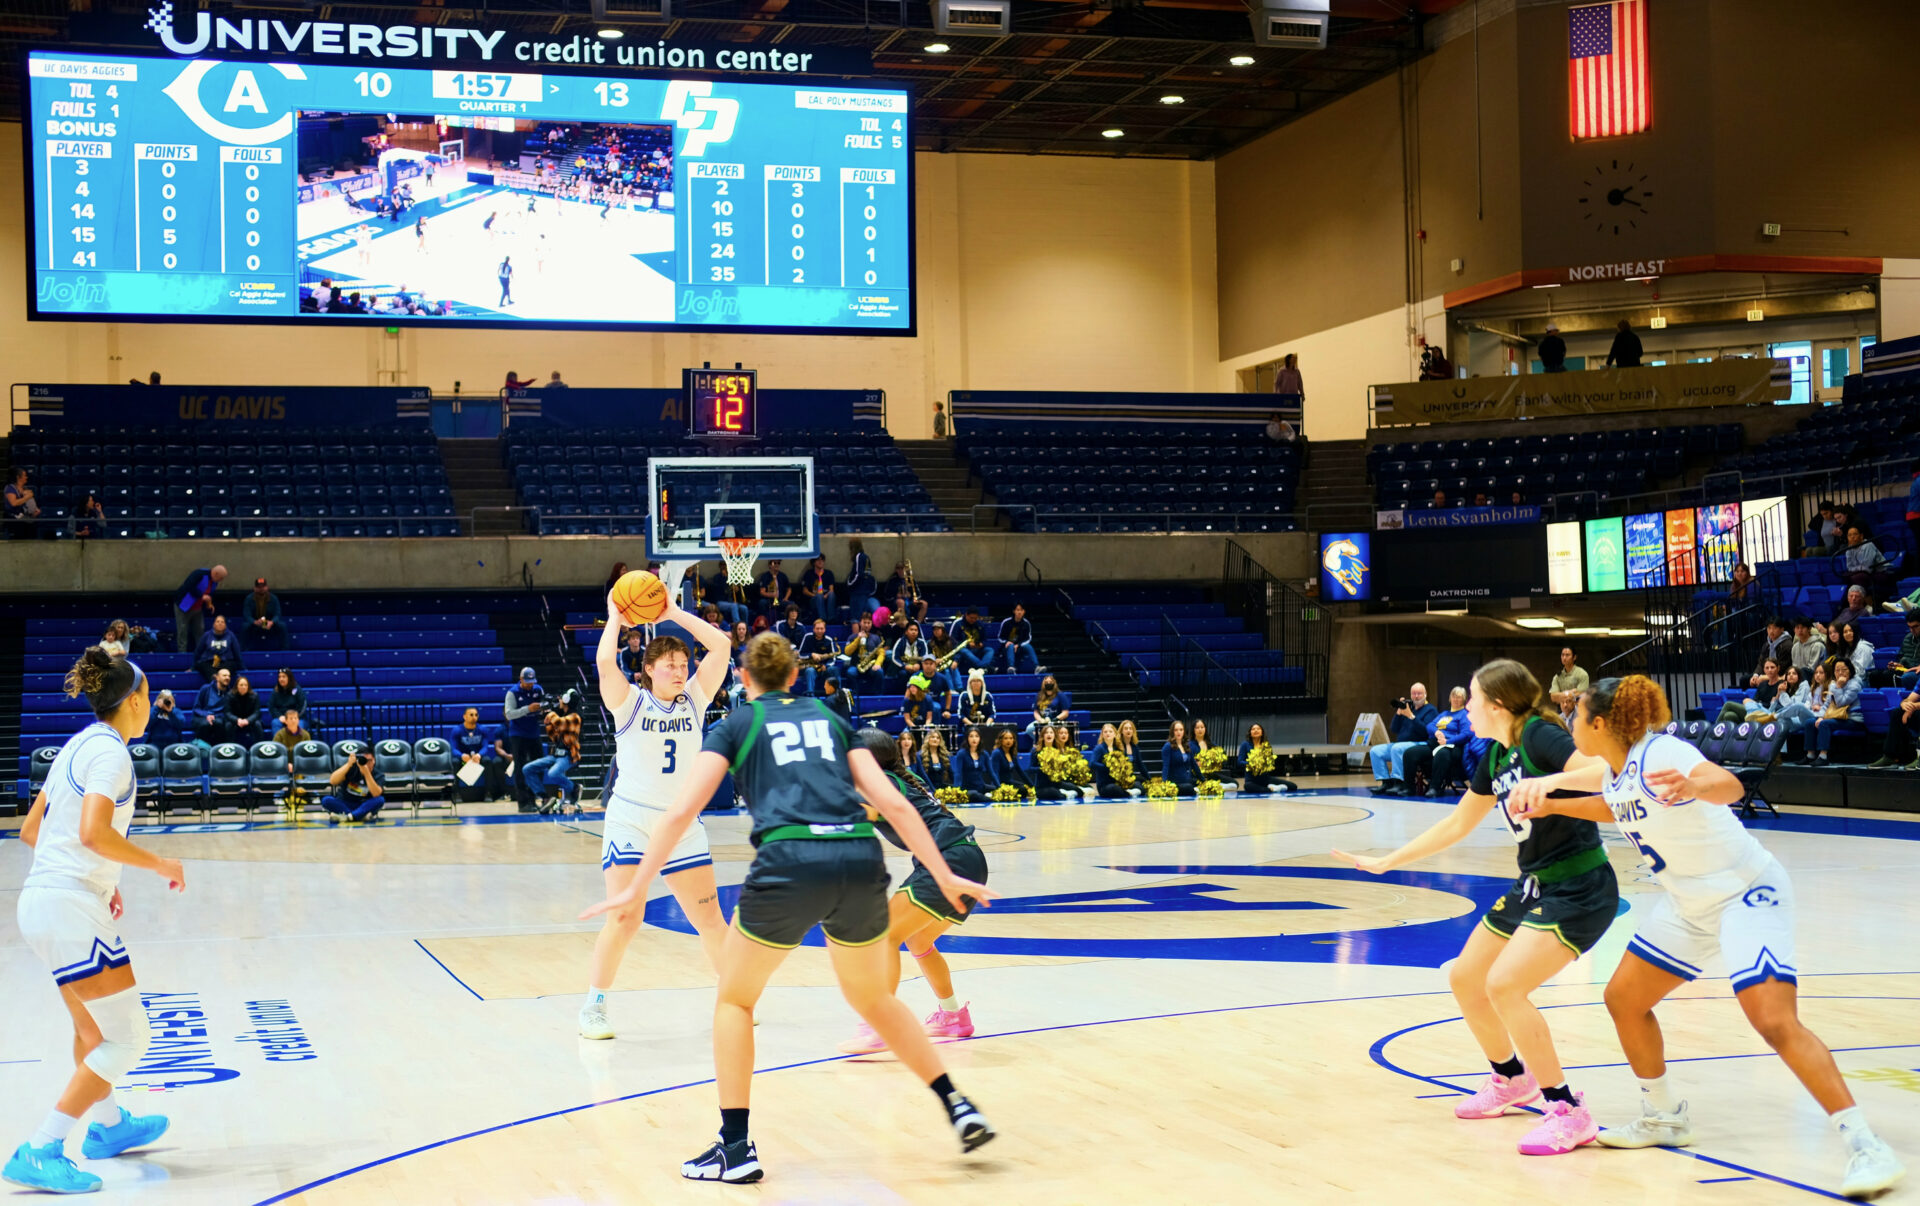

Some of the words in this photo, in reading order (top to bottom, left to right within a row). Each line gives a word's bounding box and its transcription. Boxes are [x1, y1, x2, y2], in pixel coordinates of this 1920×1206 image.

[150, 5, 505, 60] UNIVERSITY
[515, 35, 606, 65] credit
[617, 41, 705, 68] union
[715, 48, 813, 72] center
[44, 63, 56, 73] UC
[60, 64, 88, 74] DAVIS
[91, 66, 125, 76] AGGIES
[69, 82, 95, 98] TOL
[106, 85, 118, 98] 4
[354, 72, 392, 97] 10
[452, 73, 512, 97] 1:57
[594, 82, 629, 107] 13
[808, 95, 823, 105] CAL
[827, 96, 847, 106] POLY
[850, 98, 893, 108] MUSTANGS
[51, 101, 96, 117] FOULS
[110, 104, 119, 118] 1
[459, 101, 516, 113] QUARTER
[520, 103, 527, 112] 1
[46, 120, 117, 137] BONUS
[860, 117, 882, 132] TOL
[891, 119, 902, 131] 4
[844, 134, 883, 149] FOULS
[892, 136, 902, 148] 5
[56, 142, 104, 157] PLAYER
[145, 145, 191, 160] POINTS
[233, 148, 272, 162] FOULS
[76, 159, 88, 175] 3
[162, 163, 175, 177] 0
[246, 165, 259, 180] 0
[697, 164, 739, 178] PLAYER
[774, 167, 814, 181] POINTS
[852, 170, 887, 183] FOULS
[76, 182, 89, 197] 4
[162, 184, 175, 199] 0
[246, 187, 259, 201] 0
[717, 181, 729, 195] 2
[792, 183, 803, 197] 3
[866, 186, 874, 199] 1
[71, 204, 95, 219] 14
[163, 206, 176, 221] 0
[246, 208, 259, 223] 0
[712, 201, 733, 215] 10
[792, 203, 803, 217] 0
[864, 206, 876, 220] 0
[72, 227, 95, 242] 15
[164, 229, 176, 244] 5
[712, 222, 733, 236] 15
[792, 224, 804, 238] 0
[864, 226, 876, 240] 0
[1768, 224, 1778, 234] EXIT
[247, 231, 259, 246] 0
[711, 244, 735, 258] 24
[792, 246, 804, 260] 0
[867, 248, 874, 262] 1
[73, 252, 95, 267] 41
[164, 253, 177, 268] 0
[247, 255, 260, 270] 0
[712, 267, 735, 281] 35
[793, 269, 804, 283] 2
[865, 270, 876, 285] 0
[1569, 260, 1666, 281] NORTHEAST
[38, 276, 104, 303] Join
[679, 290, 738, 315] Join
[715, 377, 749, 395] 1:57
[1683, 383, 1736, 397] ucu.org
[1551, 391, 1581, 405] with
[1583, 391, 1615, 405] your
[179, 396, 208, 420] UC
[215, 396, 286, 420] DAVIS
[716, 397, 743, 429] 12
[1423, 400, 1497, 413] UNIVERSITY
[1408, 514, 1447, 527] Lena
[1451, 506, 1533, 525] Svanholm
[1430, 588, 1490, 597] DAKTRONICS
[642, 717, 657, 732] UC
[659, 717, 692, 733] DAVIS
[765, 719, 838, 766] 24
[662, 739, 677, 774] 3
[244, 999, 299, 1026] union
[125, 992, 241, 1088] UNIVERSITY
[234, 1028, 318, 1062] credit
